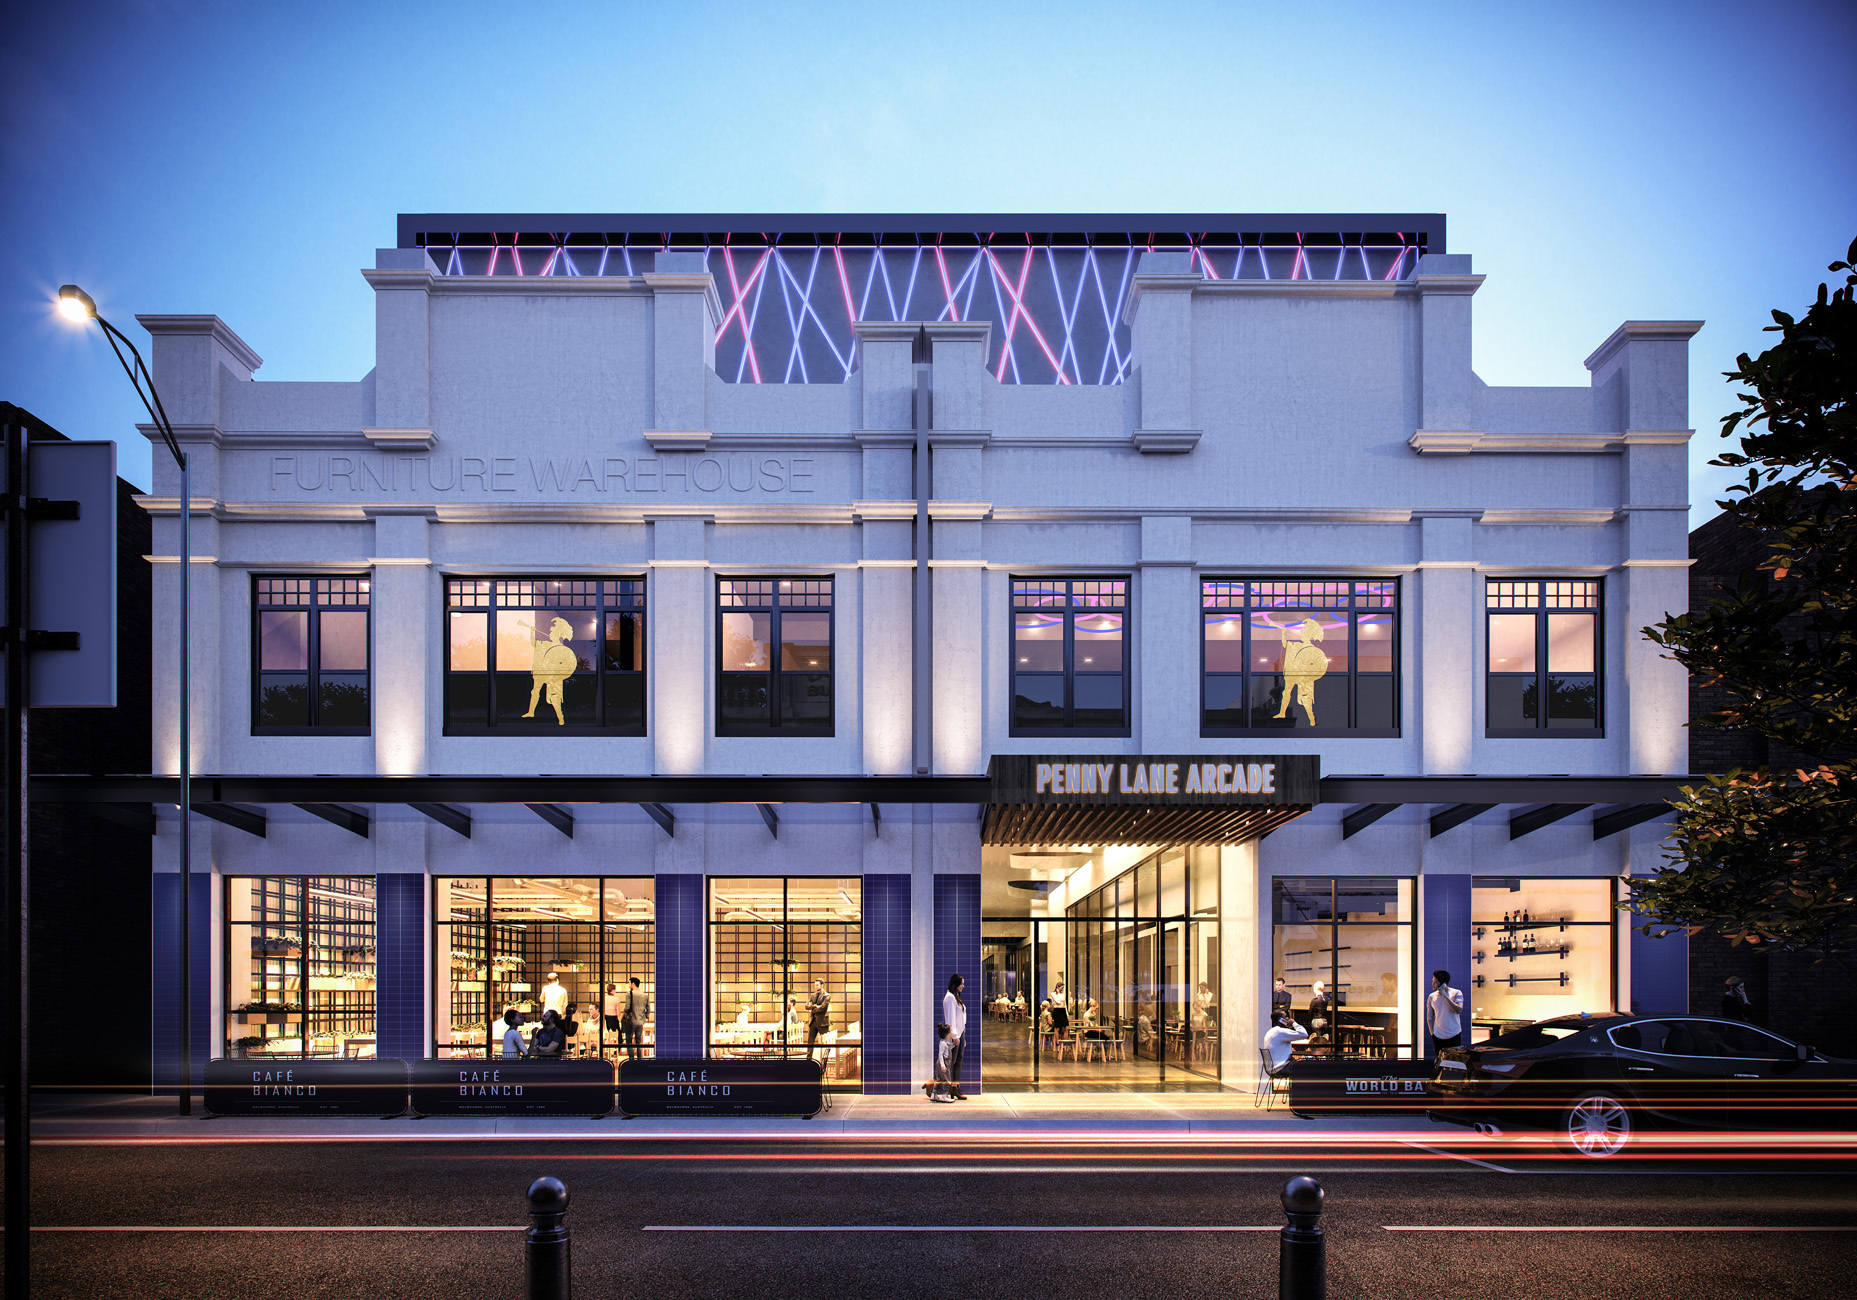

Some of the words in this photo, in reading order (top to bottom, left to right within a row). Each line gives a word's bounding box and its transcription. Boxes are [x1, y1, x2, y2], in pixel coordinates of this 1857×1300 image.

[271, 456, 516, 492] FURNITURE
[528, 457, 814, 493] WAREHOUSE
[1037, 763, 1114, 794] PENNY
[1120, 763, 1179, 794] LANE
[1186, 763, 1276, 794] ARCADE
[253, 1069, 293, 1082] CAFÉ
[460, 1069, 500, 1082] CAFÉ
[667, 1069, 708, 1082] CAFÉ
[253, 1085, 316, 1096] BIANCO
[460, 1085, 523, 1096] BIANCO
[667, 1085, 731, 1096] BIANCO
[1345, 1081, 1398, 1091] WORLD
[1404, 1081, 1428, 1091] BA
